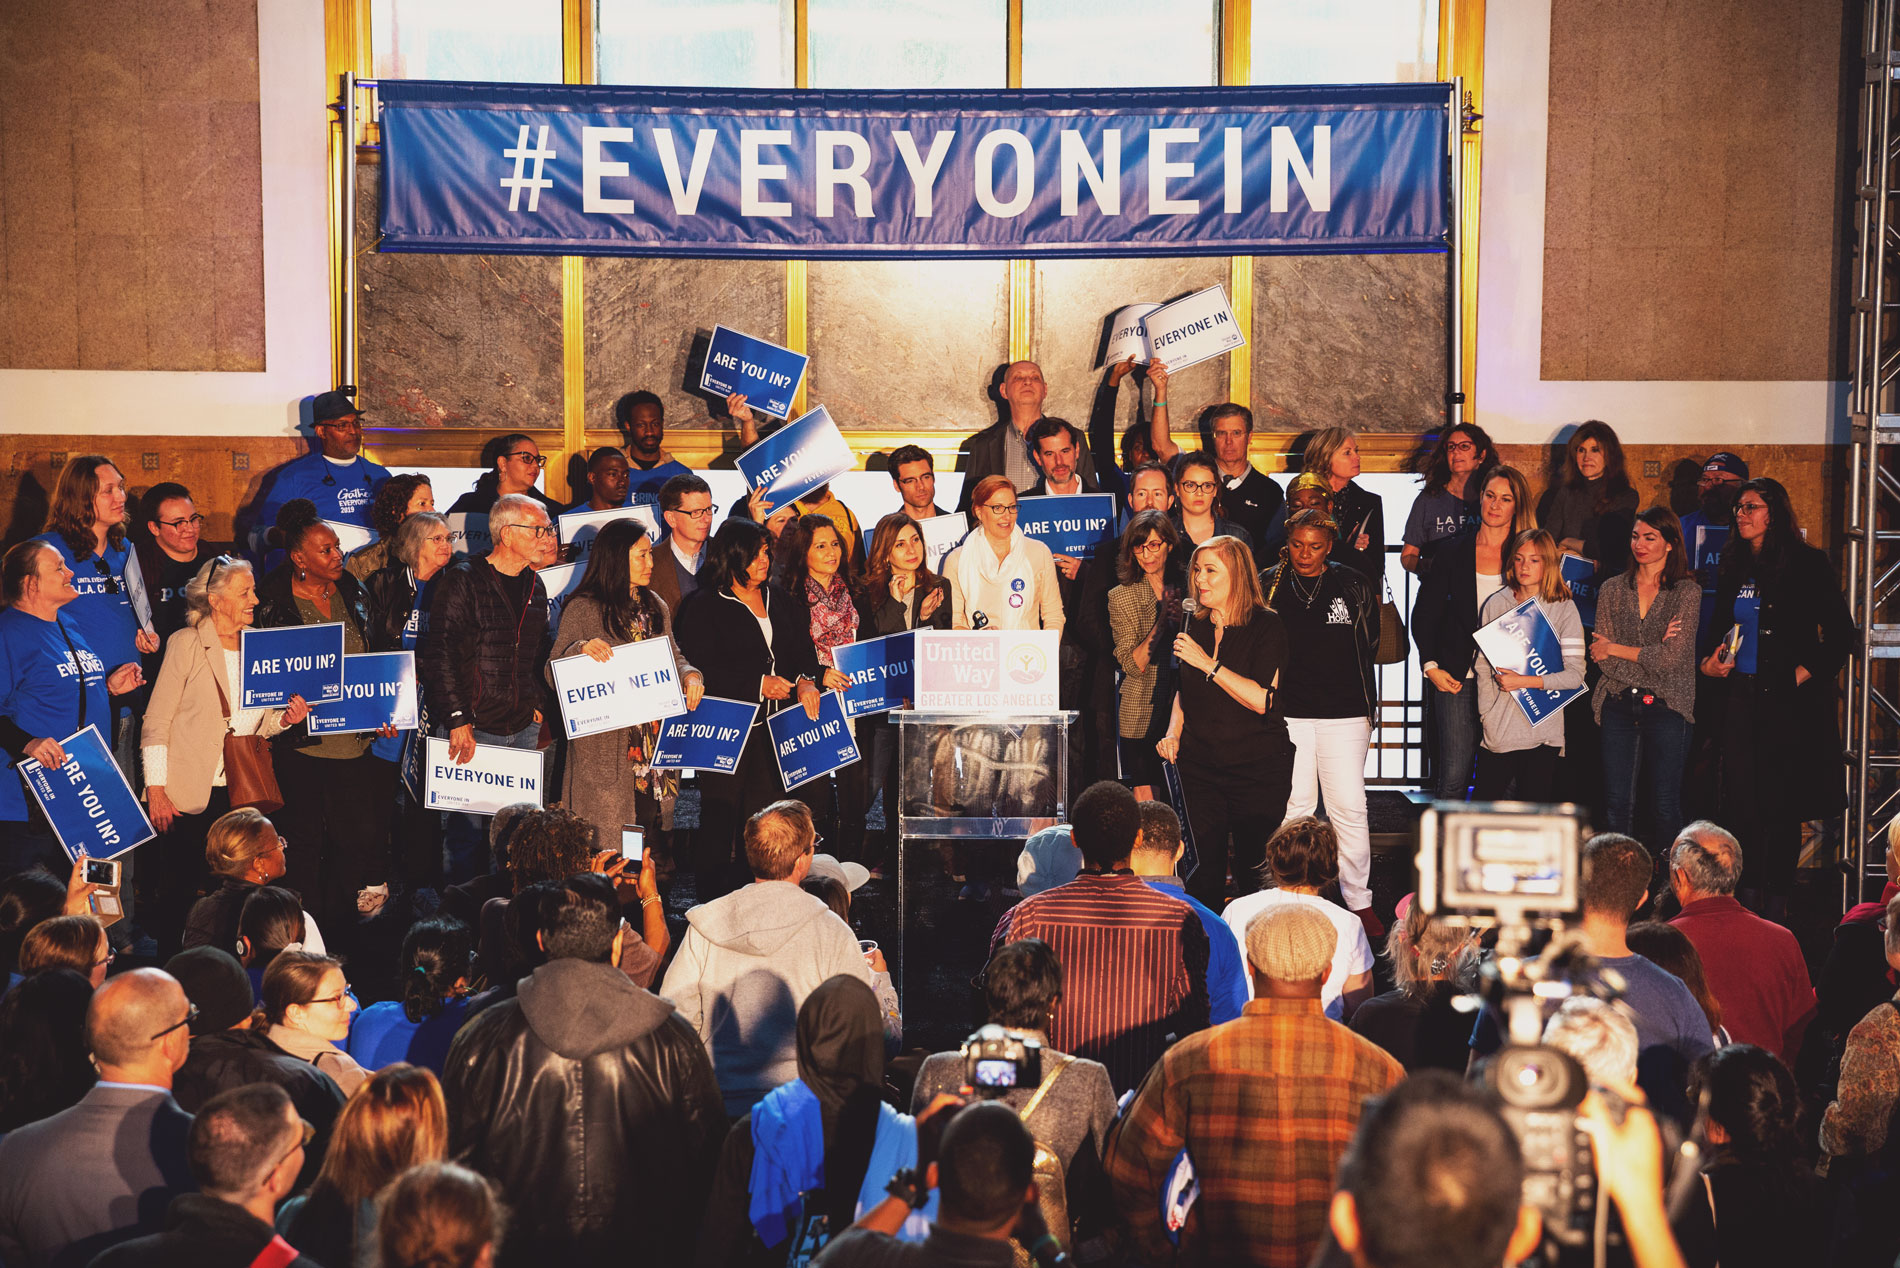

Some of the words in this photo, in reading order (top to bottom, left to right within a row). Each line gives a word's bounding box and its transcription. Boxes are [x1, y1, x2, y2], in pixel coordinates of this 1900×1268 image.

[500, 125, 1331, 217] #EVERYONEIN
[1112, 325, 1148, 344] EVERYO
[1154, 317, 1212, 350] EVERYONE
[1213, 310, 1229, 325] IN
[713, 352, 738, 370] ARE
[741, 360, 767, 380] YOU
[769, 371, 792, 389] IN?
[755, 464, 781, 486] ARE
[340, 506, 355, 514] 2019
[1436, 515, 1455, 526] LA
[1024, 521, 1050, 535] ARE
[1053, 519, 1081, 533] YOU
[1085, 518, 1107, 531] IN?
[78, 584, 96, 594] L.A.
[1505, 622, 1531, 646] ARE
[925, 642, 995, 662] United
[251, 658, 281, 675] ARE
[285, 655, 312, 672] YOU
[316, 653, 336, 669] IN?
[849, 668, 877, 685] ARE
[879, 660, 908, 679] YOU
[567, 673, 650, 704] EVERYNE
[654, 668, 671, 684] IN
[953, 664, 995, 689] Way
[344, 683, 374, 699] YOU
[380, 681, 404, 697] IN?
[921, 693, 972, 707] GREATER
[977, 693, 999, 707] LOS
[1003, 693, 1054, 707] ANGELES
[854, 699, 878, 708] EVERYONE
[666, 724, 690, 738] ARE
[691, 724, 716, 739] YOU
[716, 727, 740, 742] IN?
[780, 738, 798, 758] ARE
[797, 728, 820, 748] YOU
[821, 720, 841, 738] IN?
[435, 765, 514, 787] EVERYONE
[520, 777, 535, 790] IN
[61, 752, 87, 786] ARE
[78, 784, 106, 819] YOU
[96, 819, 121, 845] IN?
[438, 794, 463, 802] EVERYONE
